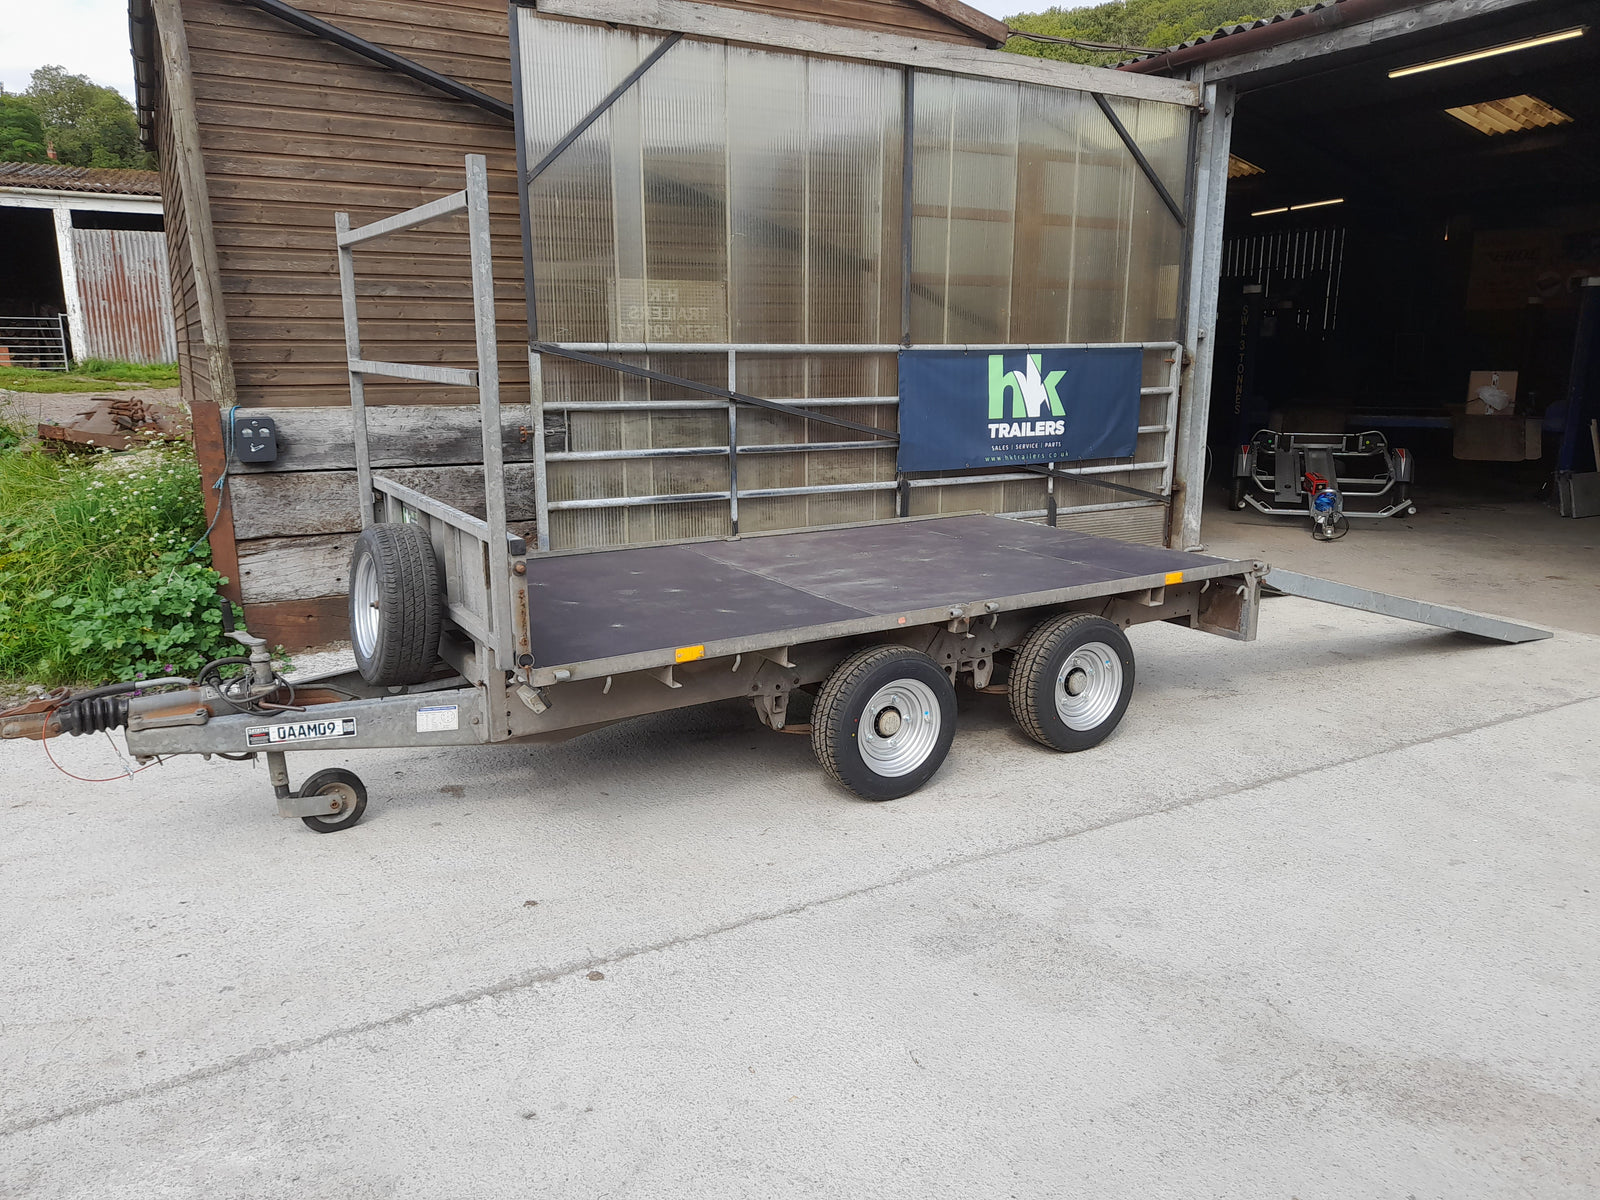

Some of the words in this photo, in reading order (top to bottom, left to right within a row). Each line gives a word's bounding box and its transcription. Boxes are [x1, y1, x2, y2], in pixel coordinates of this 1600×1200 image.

[1240, 305, 1249, 337] SWL
[1239, 340, 1247, 351] 3
[988, 353, 1067, 419] hk
[1233, 353, 1245, 415] TONNES
[988, 420, 1065, 439] TRAILERS
[1015, 442, 1038, 450] SERVICE
